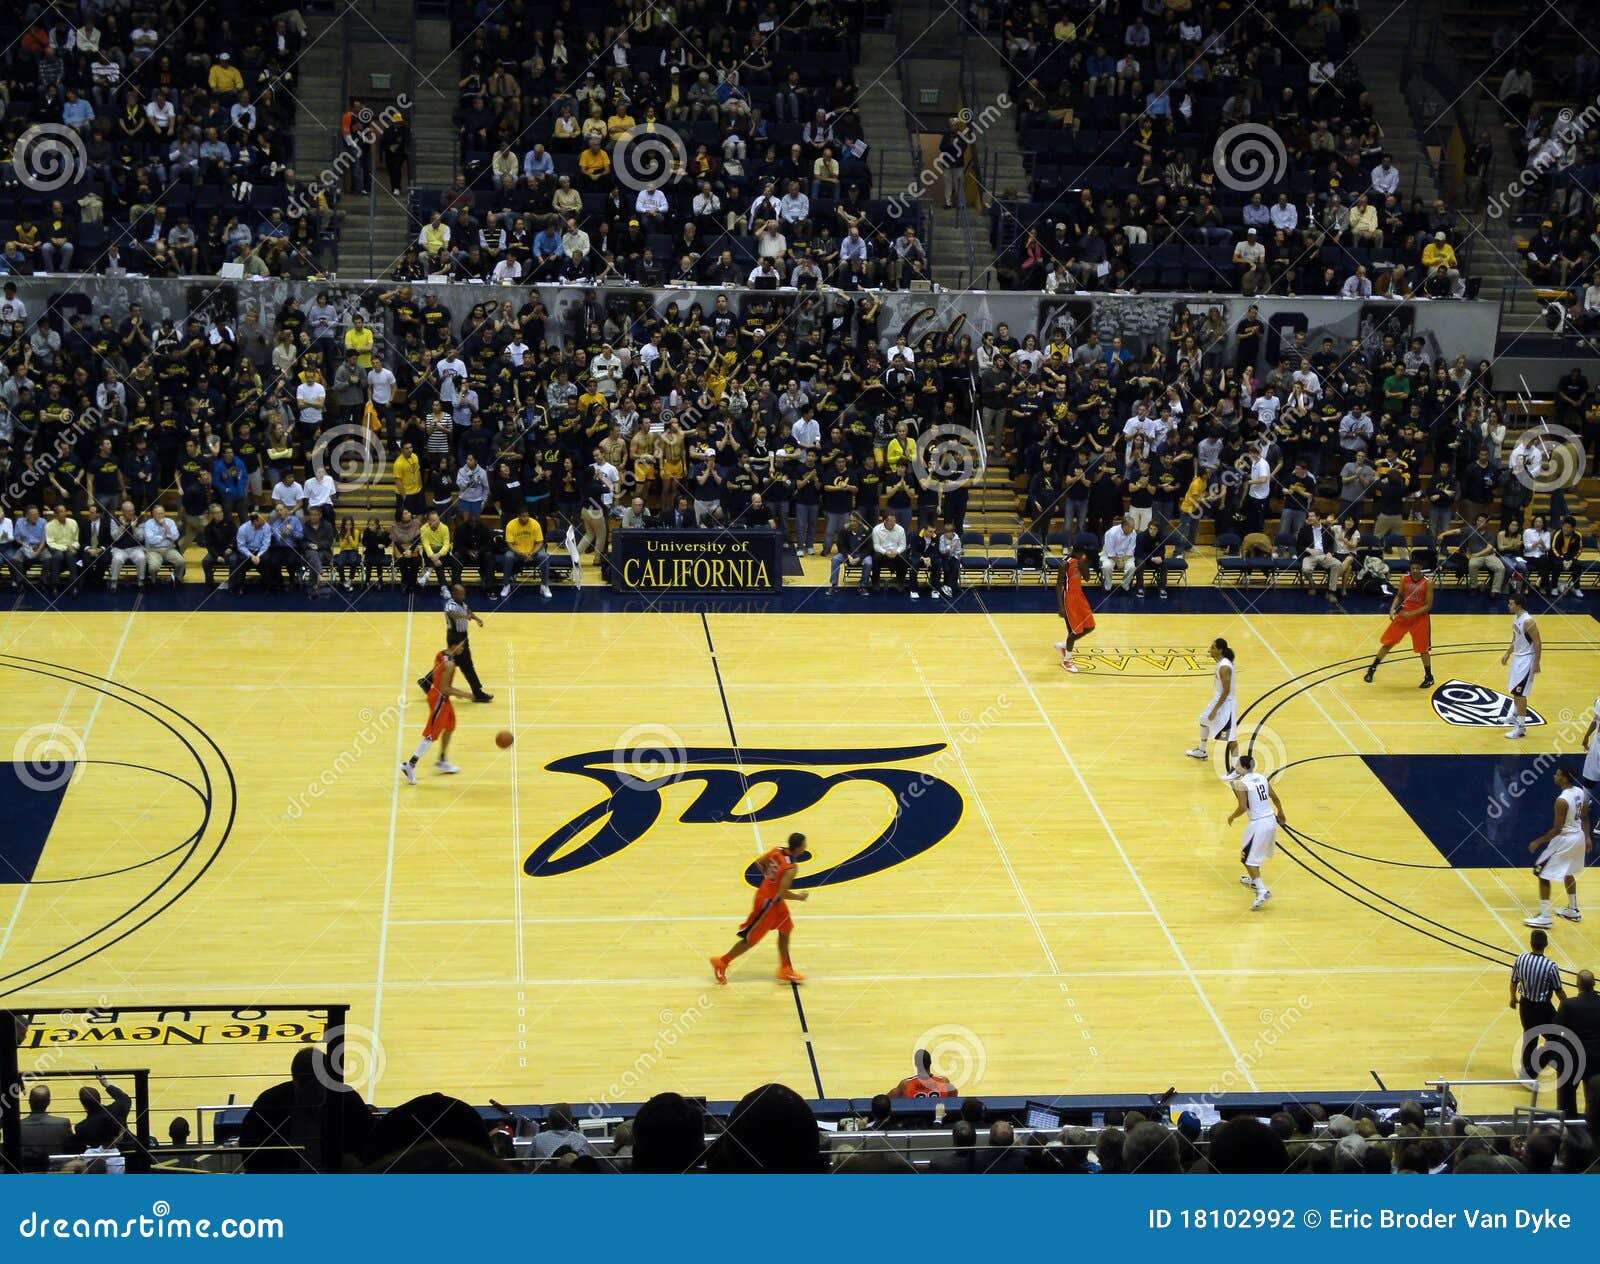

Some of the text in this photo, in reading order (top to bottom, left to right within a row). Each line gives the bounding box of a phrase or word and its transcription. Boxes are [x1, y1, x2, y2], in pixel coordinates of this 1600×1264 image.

[544, 449, 561, 463] Cal
[833, 475, 849, 487] Cal
[647, 540, 750, 555] University of
[623, 558, 772, 588] CALIFORNIA
[1255, 784, 1268, 801] 12
[523, 741, 965, 890] Cal
[29, 1021, 328, 1049] Pete Newel
